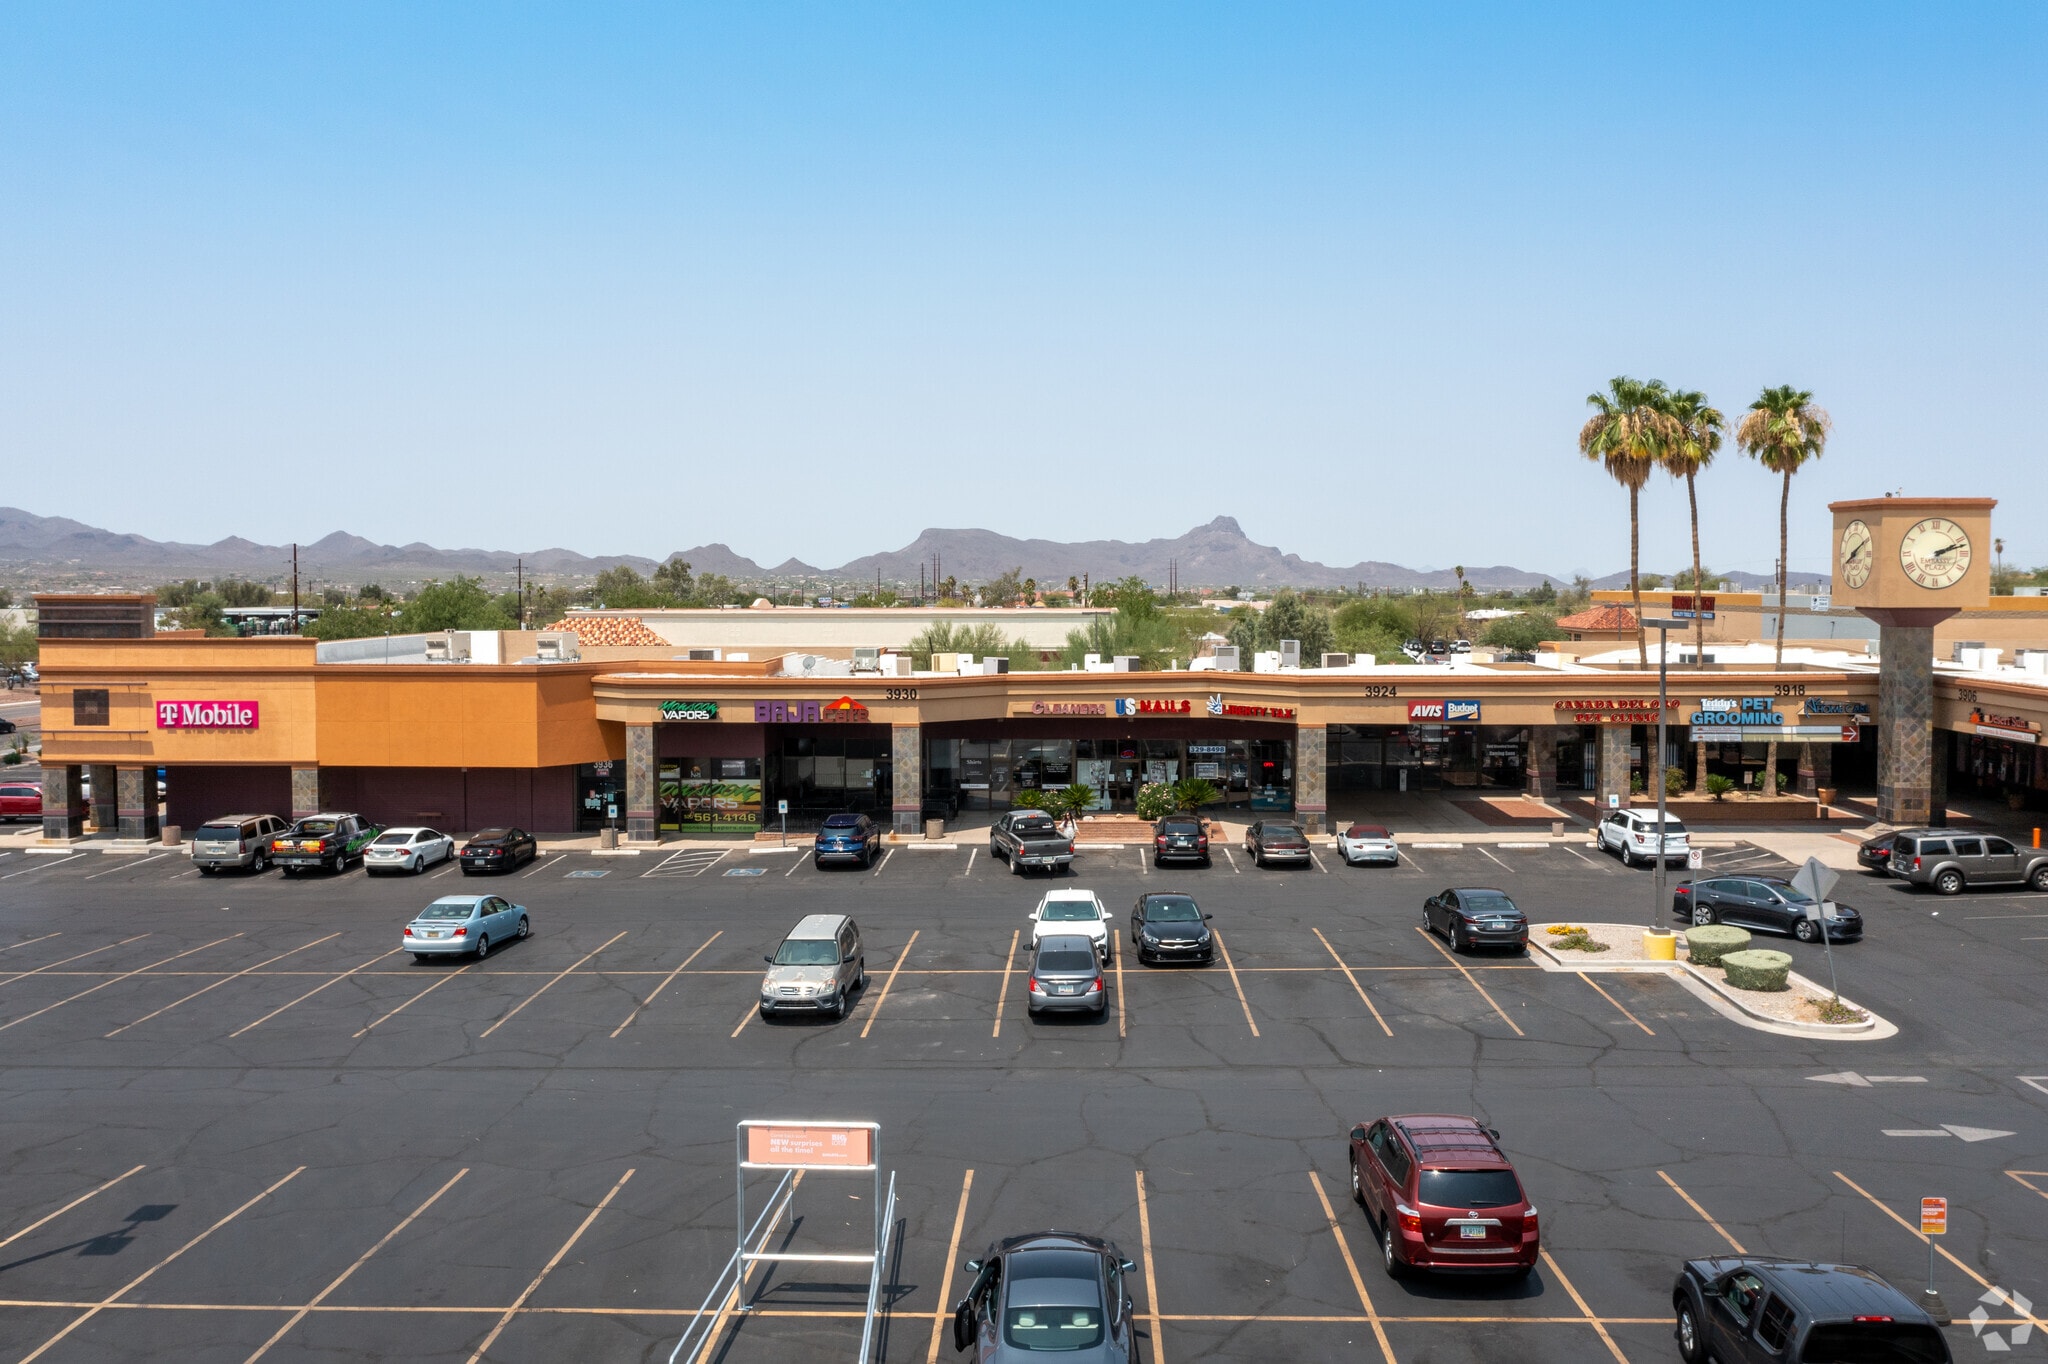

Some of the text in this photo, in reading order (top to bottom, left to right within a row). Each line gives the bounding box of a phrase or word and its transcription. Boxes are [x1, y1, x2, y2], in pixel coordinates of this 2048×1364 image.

[886, 688, 917, 700] 3930
[1365, 686, 1397, 697] 3924
[1774, 684, 1805, 696] 3918
[1958, 688, 1977, 702] 3906
[657, 700, 719, 714] Monsoon
[1115, 697, 1191, 716] US NAILS
[1447, 702, 1478, 713] Budget
[1618, 699, 1648, 709] DEL
[1741, 697, 1775, 710] PET
[181, 703, 253, 725] Mobile
[662, 710, 710, 720] VAPORS
[754, 701, 820, 723] BAJA
[1222, 704, 1293, 718] LIBERTY TAX
[1411, 705, 1443, 717] AVIS
[1575, 712, 1660, 722] PET CLINIC
[1691, 711, 1784, 725] GROOMING
[593, 760, 613, 768] 3936
[660, 797, 738, 808] VAPORS
[694, 813, 756, 822] 561-4146
[770, 1138, 823, 1147] NEW surprises
